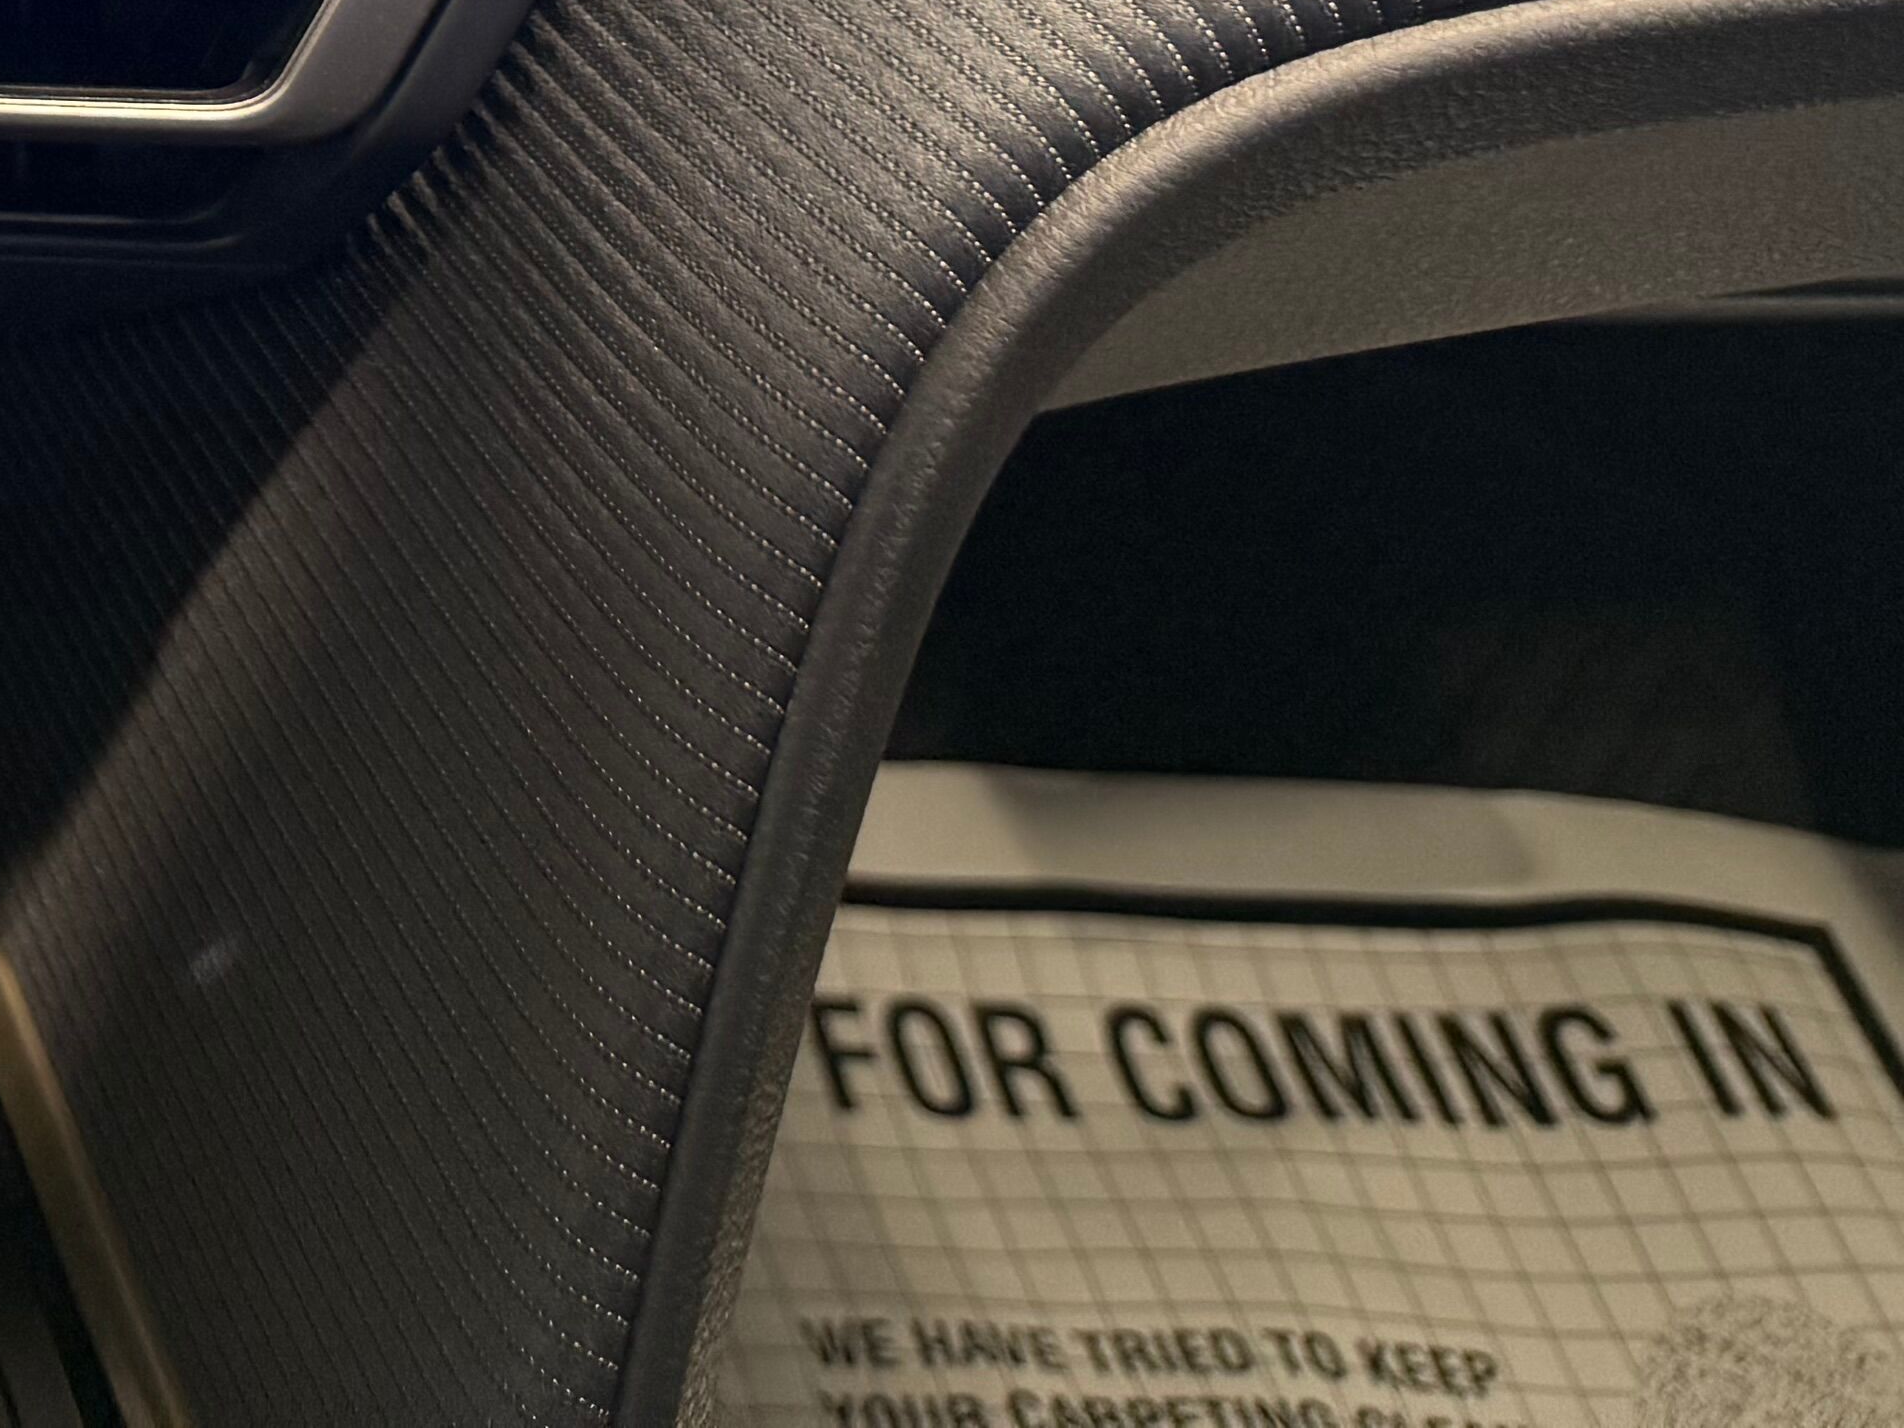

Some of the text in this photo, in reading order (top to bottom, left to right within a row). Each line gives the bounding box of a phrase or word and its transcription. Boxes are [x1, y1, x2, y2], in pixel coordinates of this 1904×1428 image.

[810, 996, 1840, 1128] FOR COMING IN
[798, 1316, 1499, 1398] WE HAVE TRIED TO KEEP
